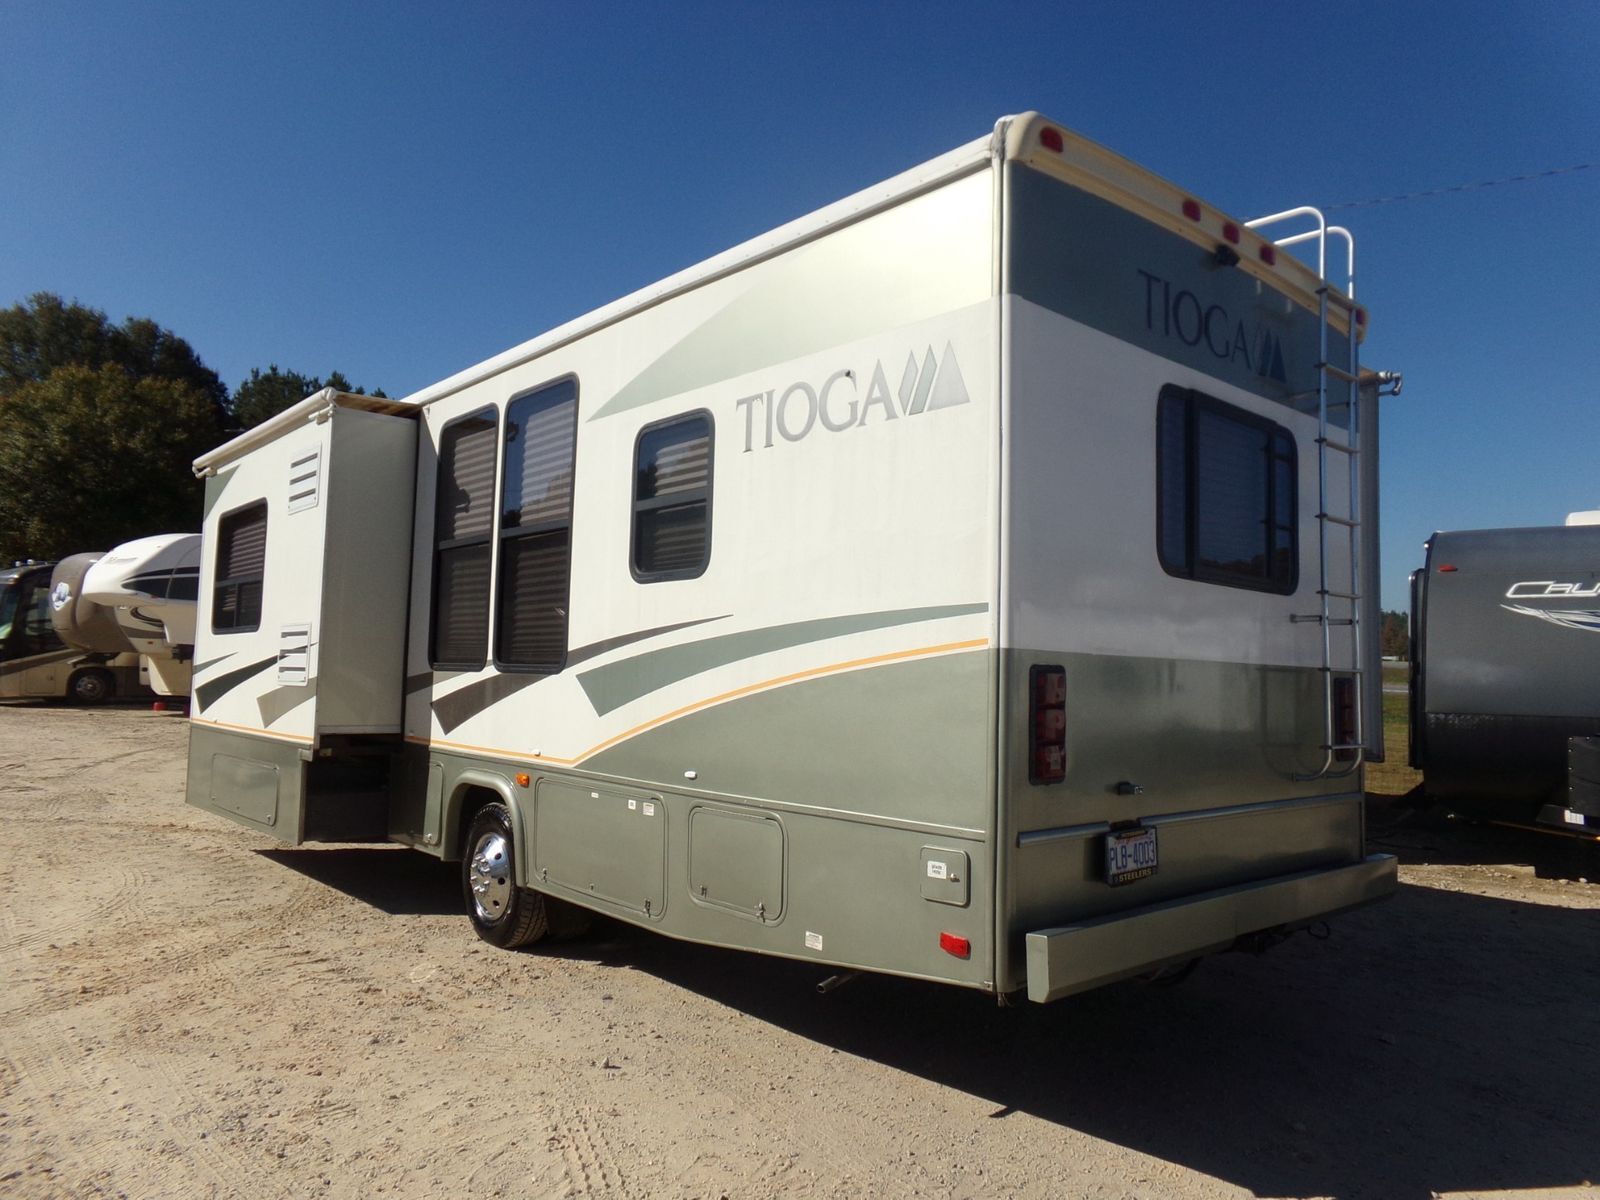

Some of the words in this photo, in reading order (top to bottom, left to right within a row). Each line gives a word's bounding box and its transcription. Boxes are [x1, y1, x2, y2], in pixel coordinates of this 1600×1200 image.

[1137, 268, 1251, 370] TIOGA
[736, 358, 899, 453] TIOGA
[1119, 868, 1152, 882] STEELERS
